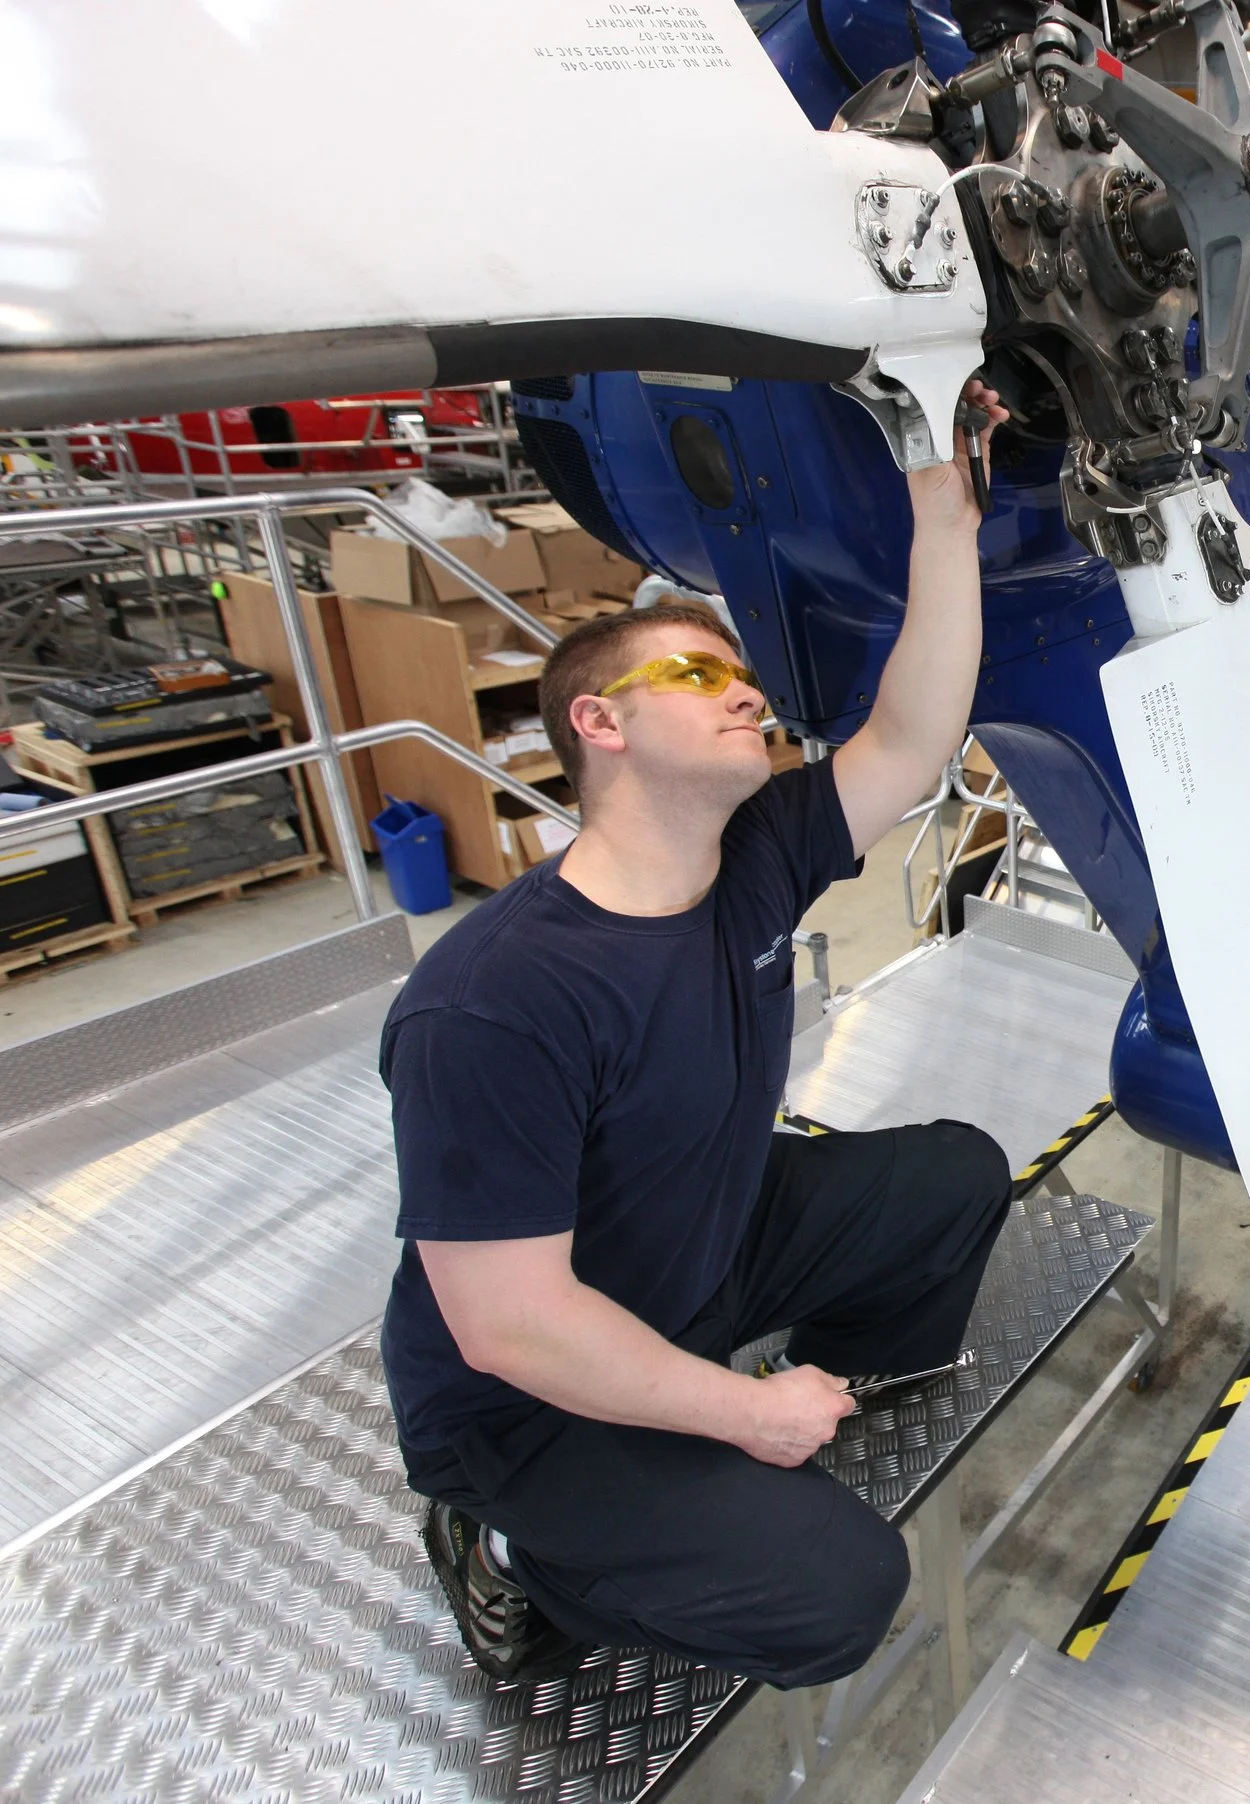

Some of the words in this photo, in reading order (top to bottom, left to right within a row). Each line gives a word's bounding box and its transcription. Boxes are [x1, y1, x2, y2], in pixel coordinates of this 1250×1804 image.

[585, 18, 645, 28] AIRCRAFT
[649, 18, 707, 29] SIKORSKY
[556, 47, 583, 56] SAC
[681, 45, 724, 54] SERIAL
[678, 59, 700, 68] NO.
[703, 60, 732, 68] PART
[1169, 681, 1178, 702] PART
[1162, 684, 1171, 715] SERIAL
[1148, 691, 1161, 732] SIKORSKY
[1157, 736, 1170, 774] AIRCRAFT
